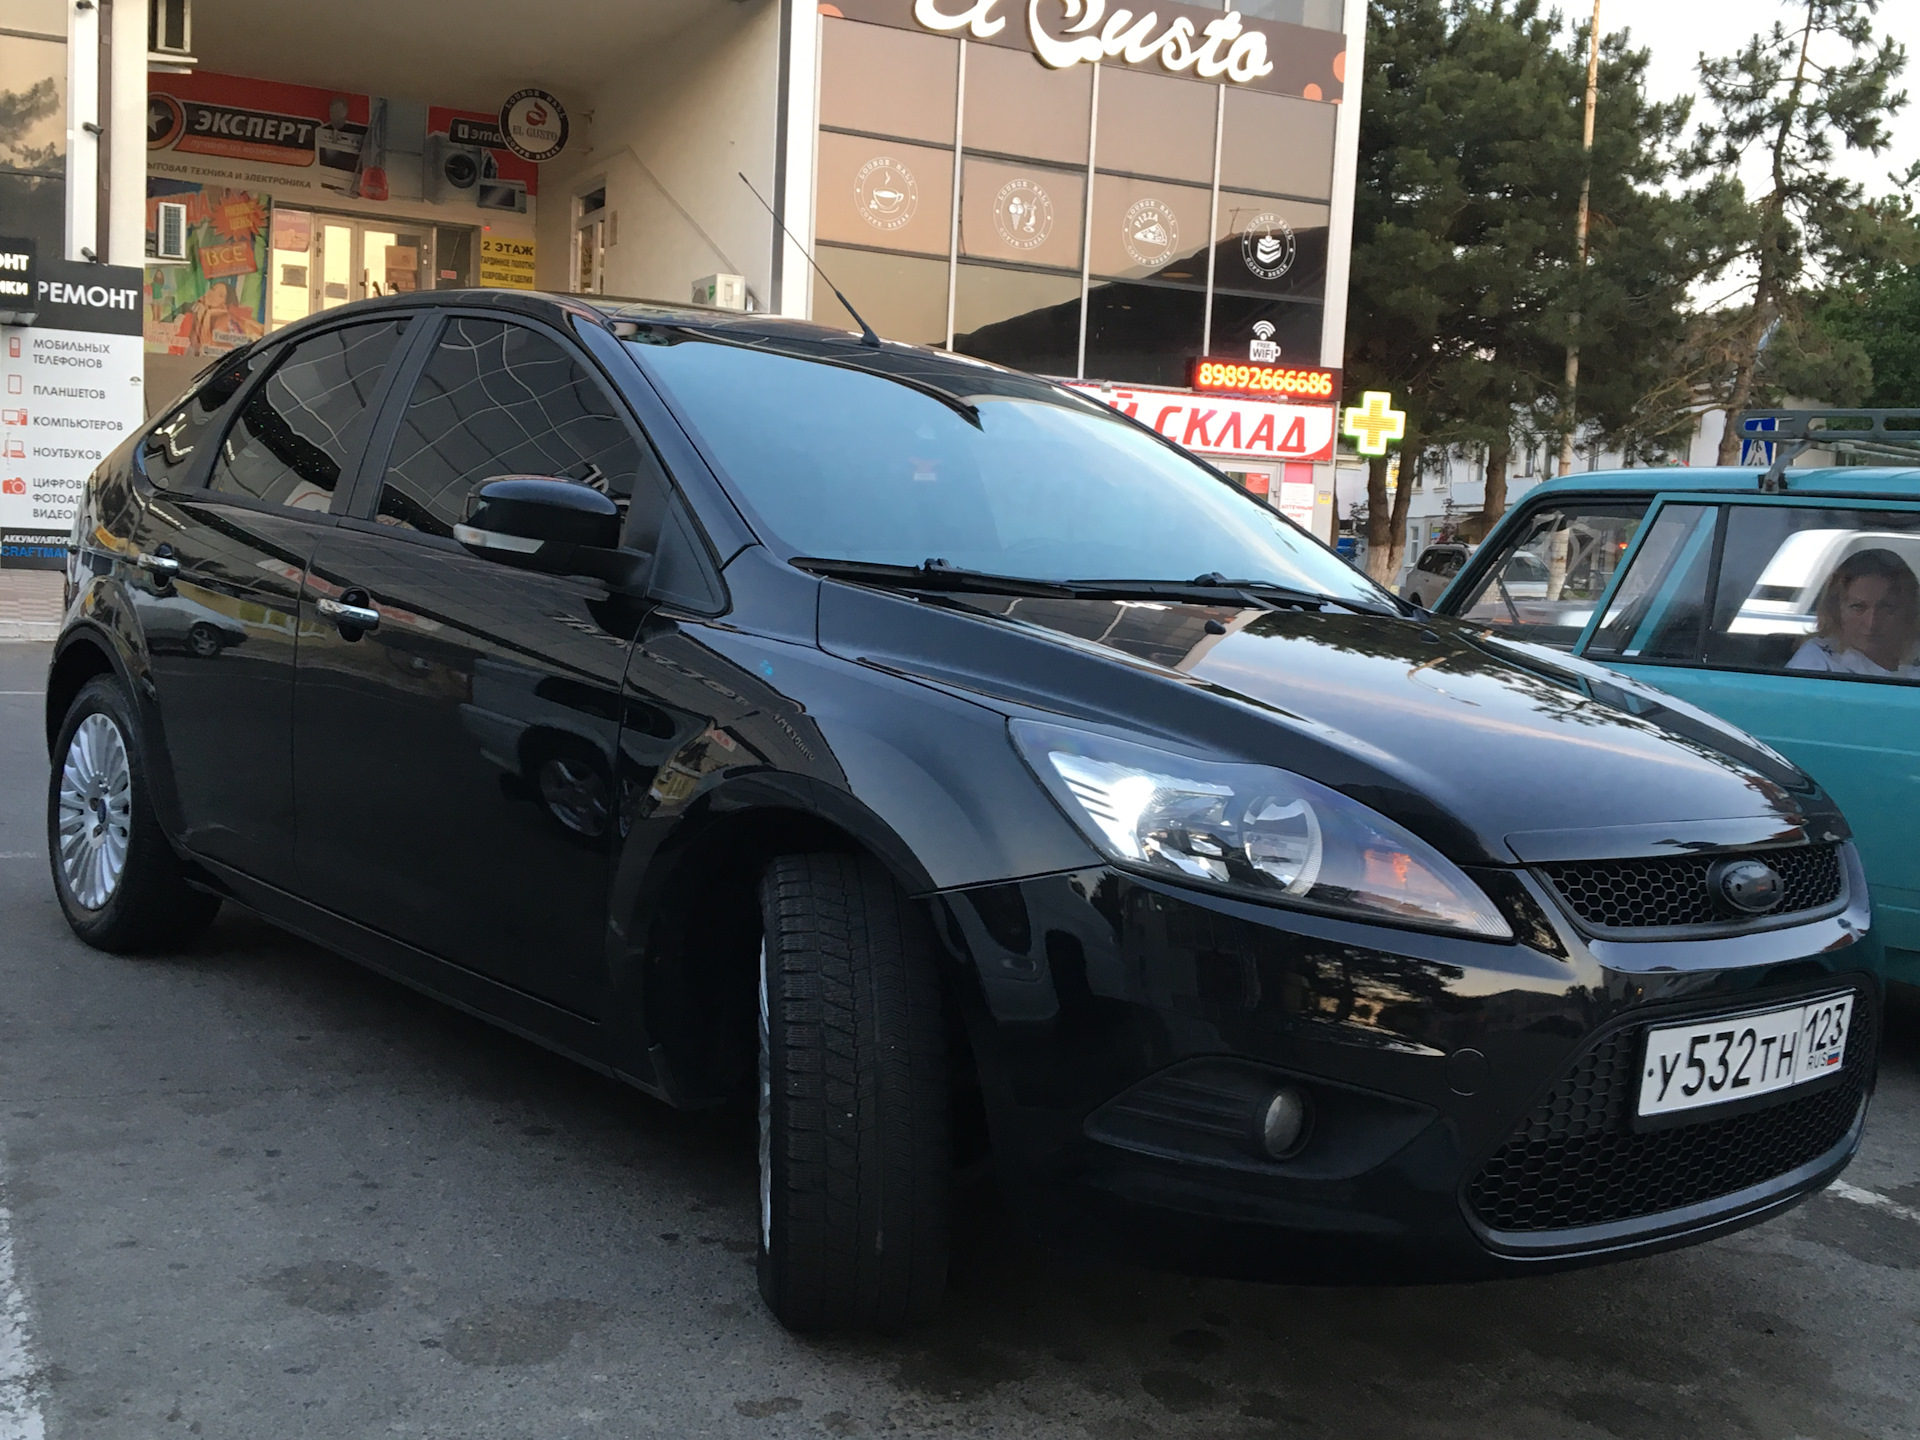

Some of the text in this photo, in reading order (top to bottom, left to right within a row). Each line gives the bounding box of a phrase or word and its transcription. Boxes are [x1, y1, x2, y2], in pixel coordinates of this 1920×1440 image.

[194, 110, 312, 144] ЭКСПЕРТ
[512, 125, 557, 141] EL GUSTO
[191, 166, 234, 179] ТЕХНИКА
[235, 173, 243, 181] И
[244, 174, 312, 189] ЭЛЕКТРОНИКА
[1134, 212, 1158, 228] PIZZA
[205, 246, 248, 267] ВСЕ
[483, 241, 534, 256] 2 ЭТАЖ
[38, 281, 138, 310] РЕМОНТ
[33, 339, 110, 354] МОБИЛЬНЫХ
[1252, 348, 1274, 359] WIFI
[33, 354, 103, 369] ТЕЛЕФОНОВ
[1199, 362, 1332, 396] 89892666686
[33, 385, 106, 400] ПЛАНШЕТОВ
[33, 416, 123, 431] КОМПЬЮТЕРОВ
[1153, 405, 1307, 453] СКЛАД
[33, 447, 102, 460] НОУТБУКОВ
[33, 508, 76, 520] ВИДЕО
[1656, 1002, 1846, 1103] У532ТН 123
[1807, 1051, 1828, 1071] RUS
